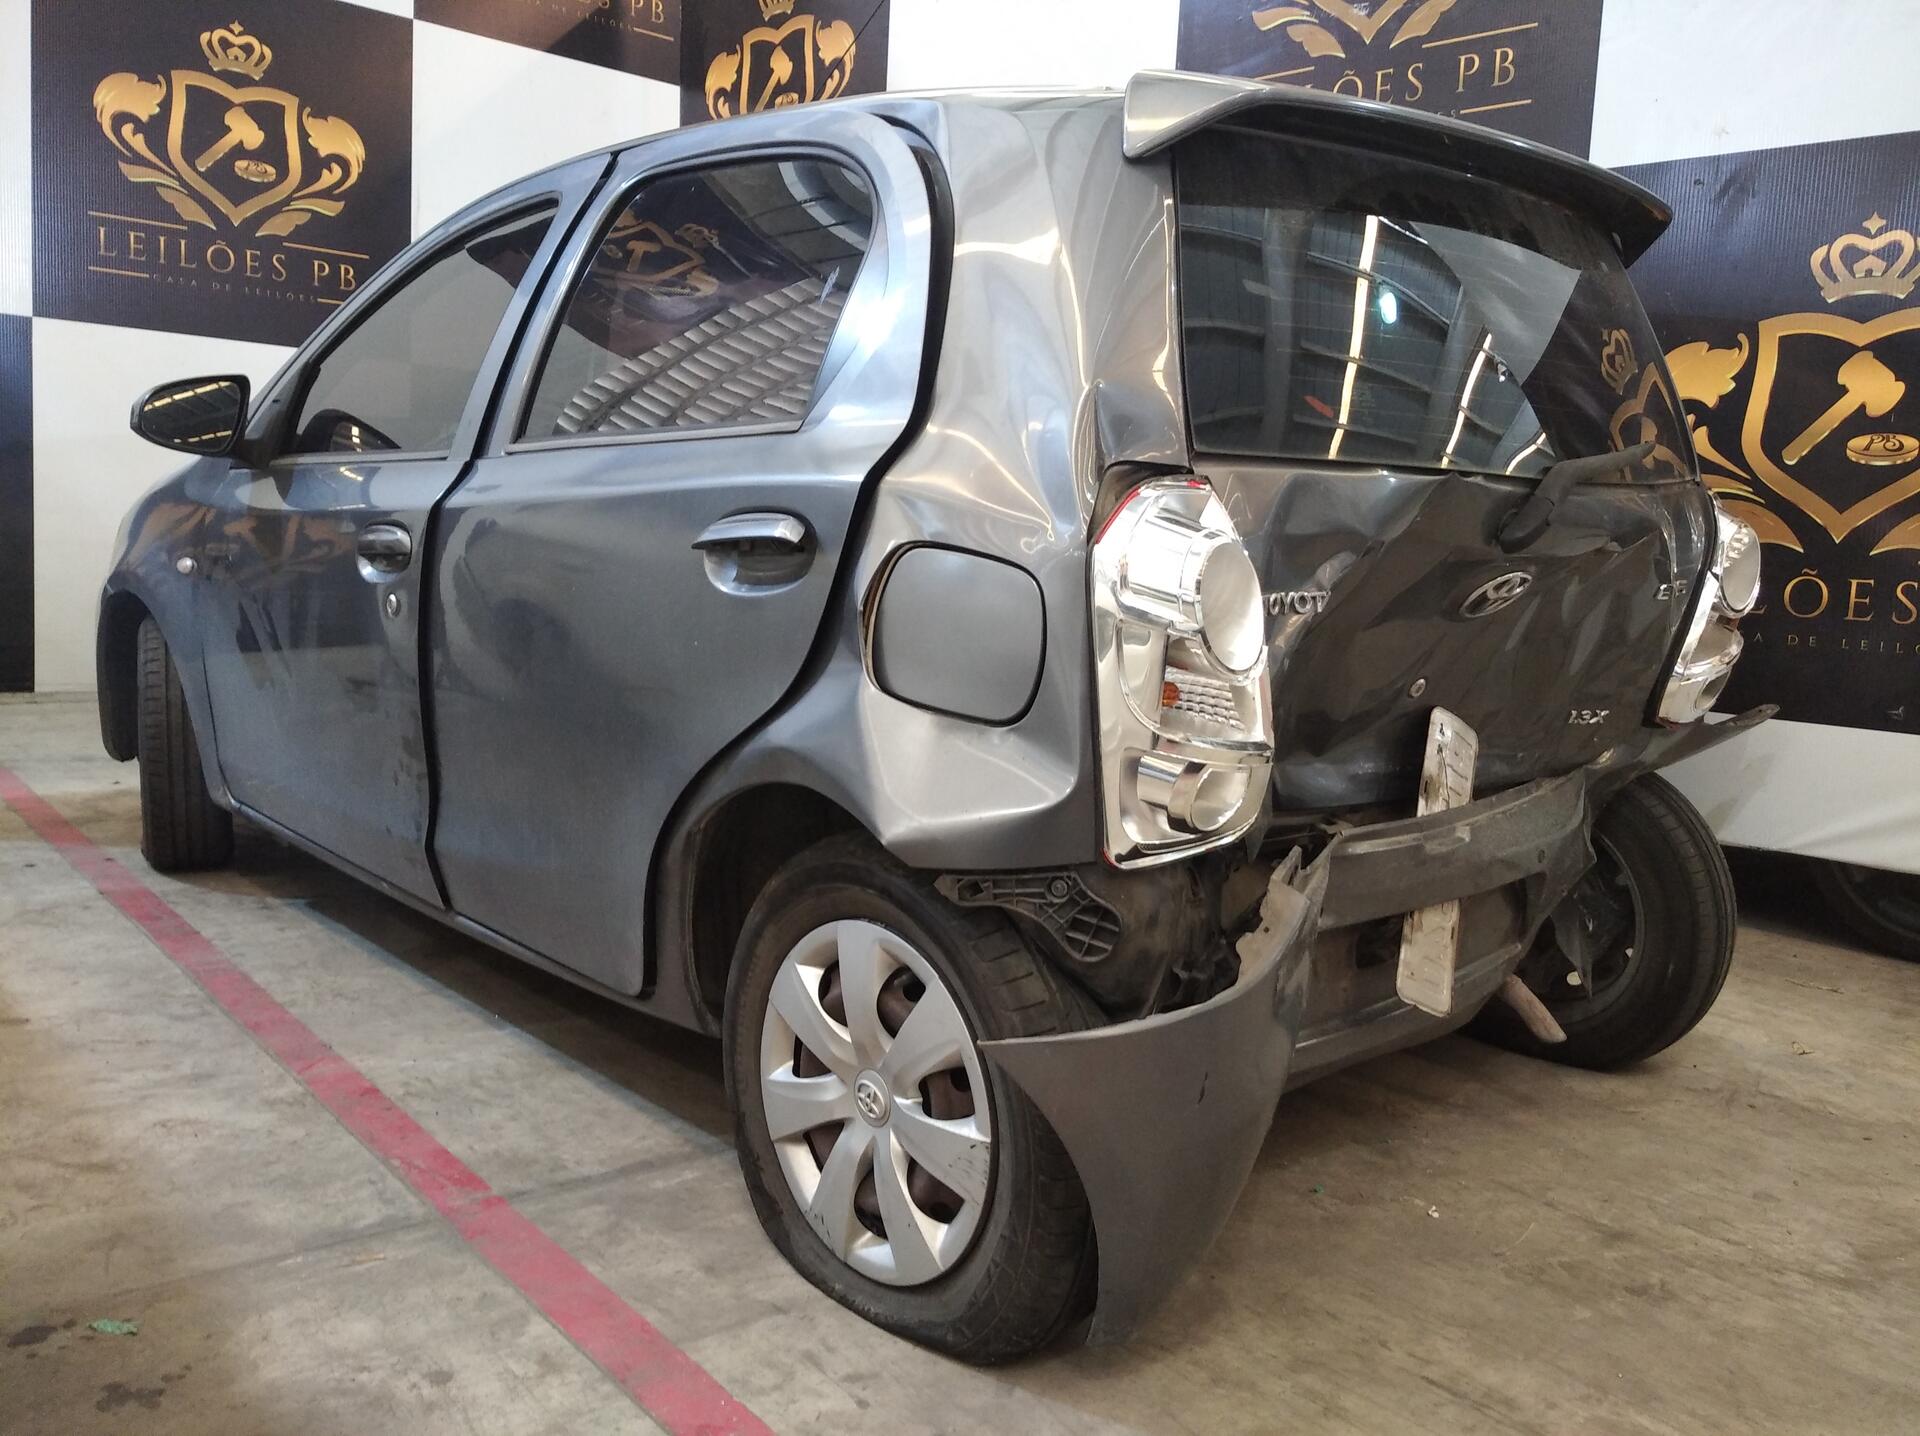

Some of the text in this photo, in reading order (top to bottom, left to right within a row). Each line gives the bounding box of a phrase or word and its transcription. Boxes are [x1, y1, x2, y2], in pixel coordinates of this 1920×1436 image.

[630, 0, 665, 24] PB
[1305, 47, 1516, 105] ÕES PB
[98, 226, 357, 291] LEILÕES PB
[1749, 567, 1920, 626] ÕES
[1787, 633, 1920, 656] DE LEIL
